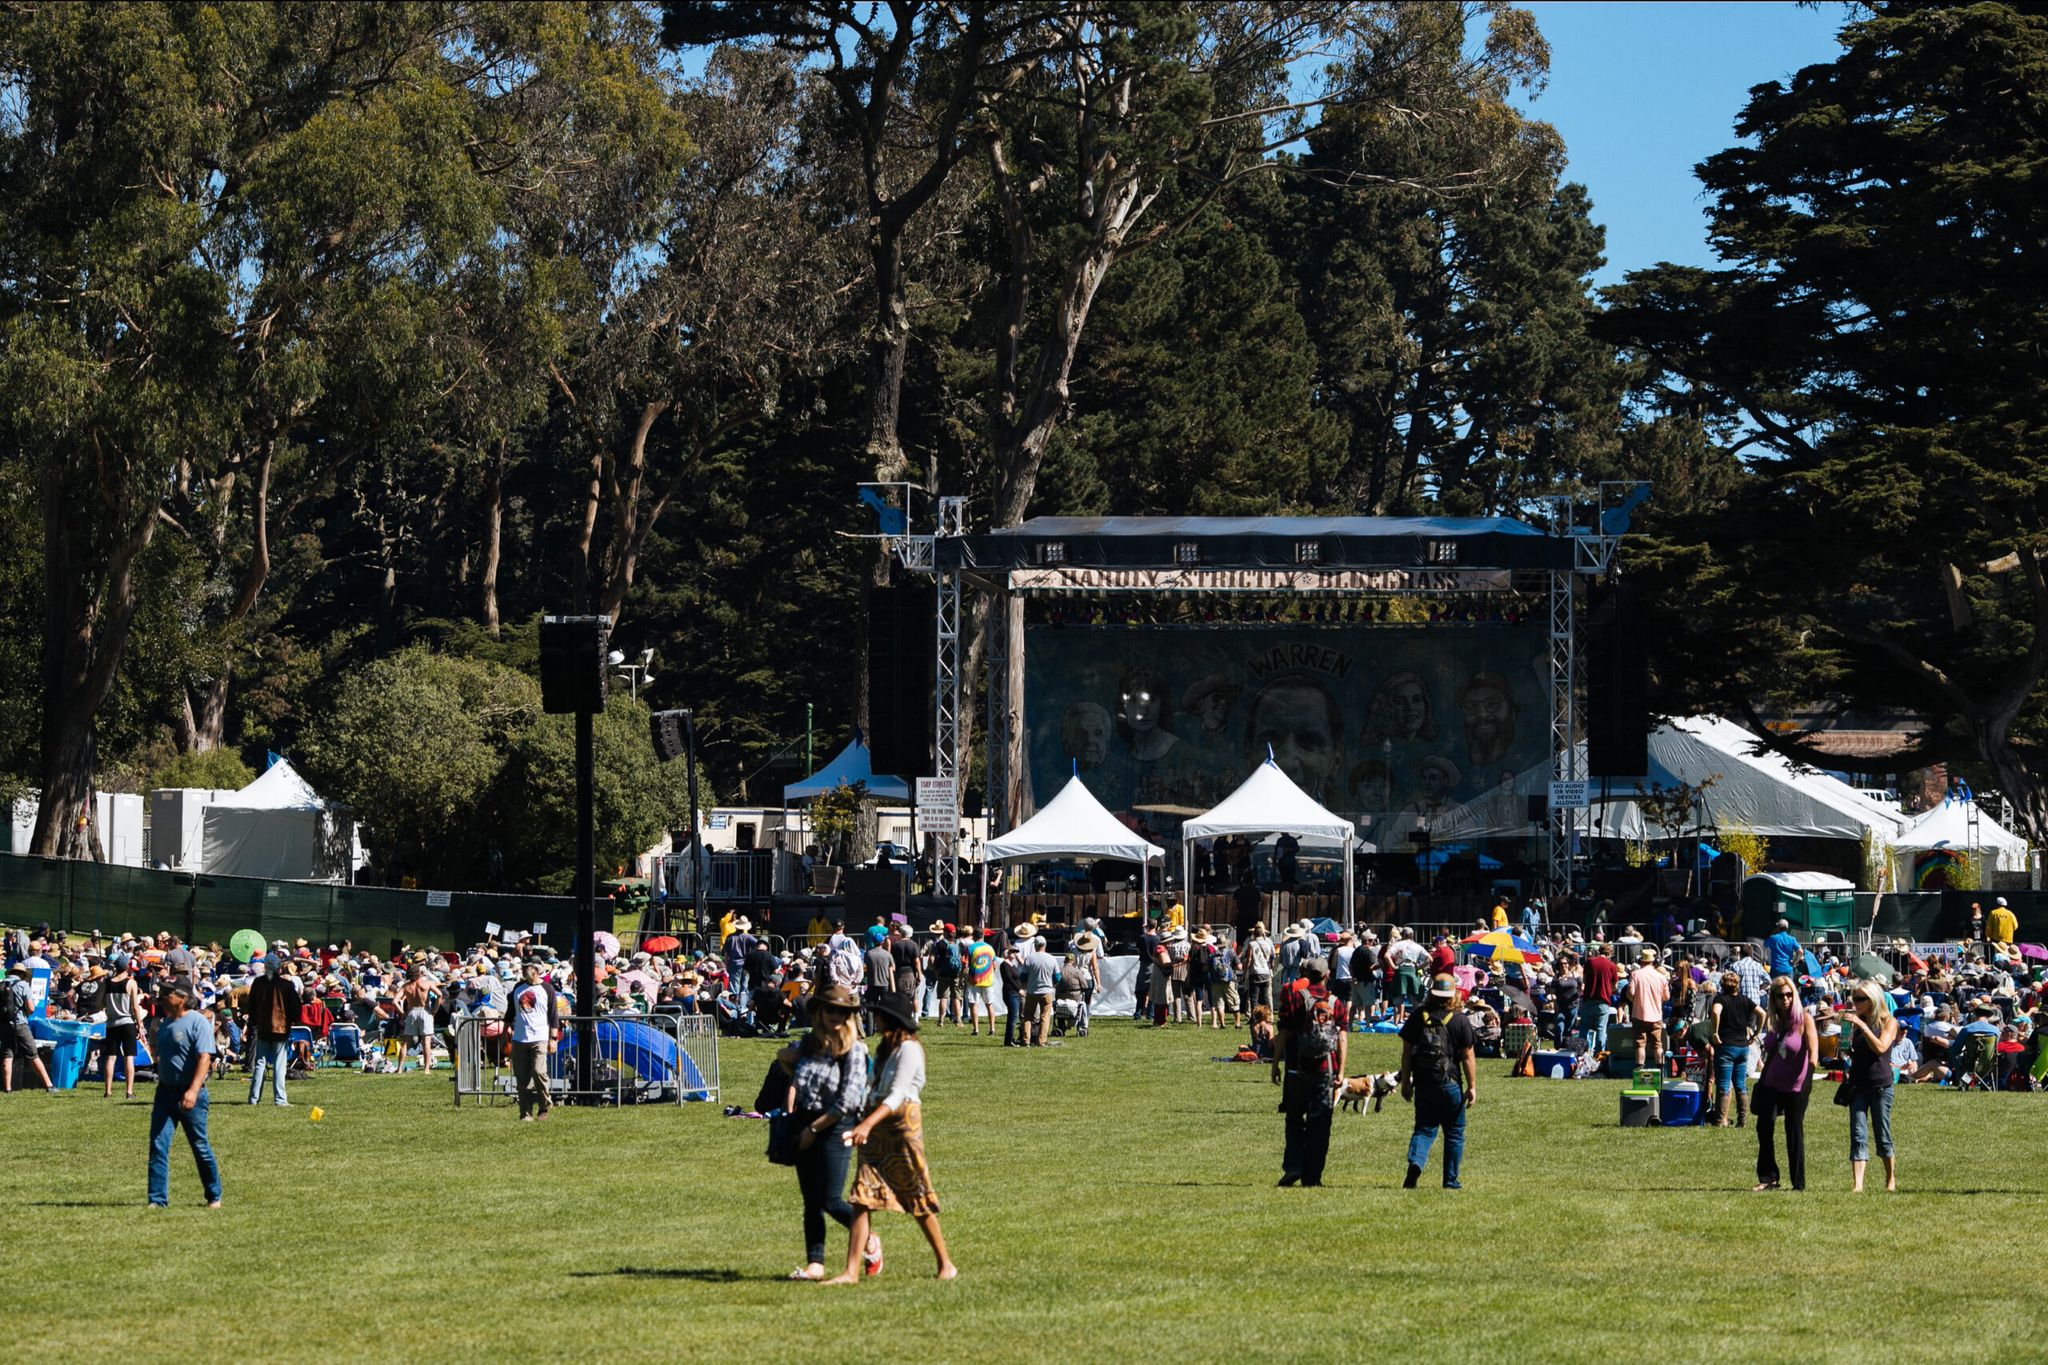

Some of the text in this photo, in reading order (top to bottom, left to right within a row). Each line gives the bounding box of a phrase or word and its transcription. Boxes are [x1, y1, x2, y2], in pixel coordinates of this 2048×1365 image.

[1059, 570, 1460, 589] HARDLY STRICTLY BLUEGRASS
[1246, 642, 1355, 681] WARREN
